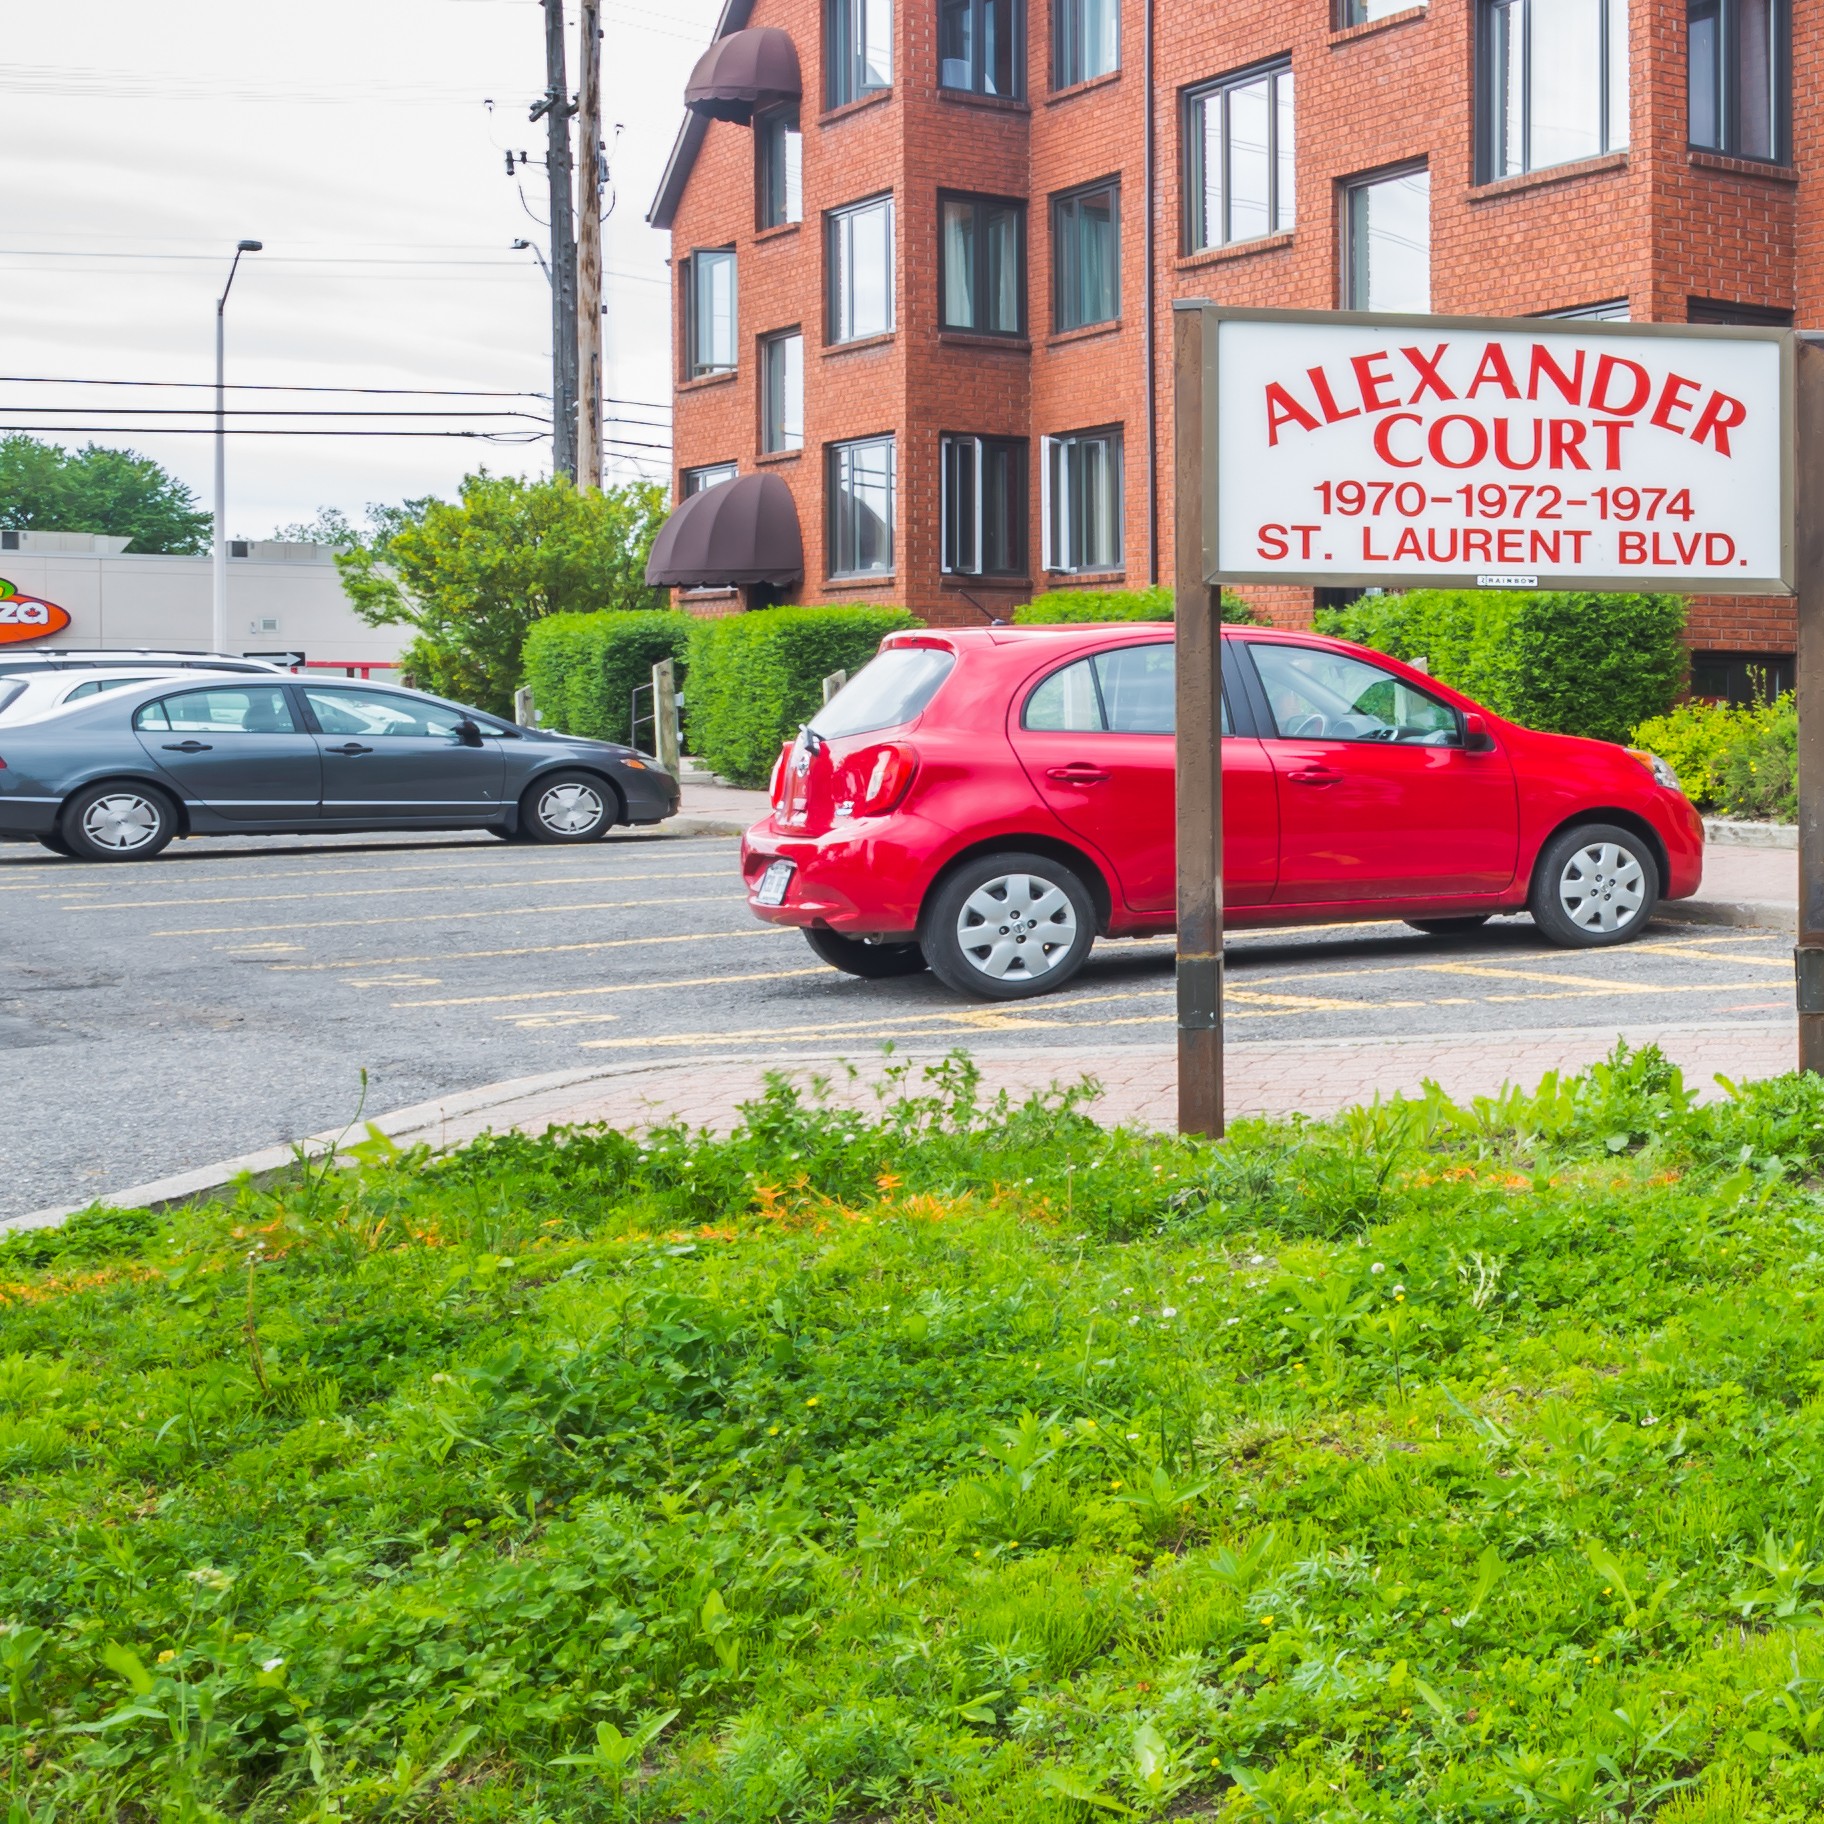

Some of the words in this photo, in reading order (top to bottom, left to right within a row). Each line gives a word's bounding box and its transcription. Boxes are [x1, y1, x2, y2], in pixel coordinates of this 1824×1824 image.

[1265, 342, 1747, 458] ALEXANDER
[1372, 412, 1635, 471] COURT
[1313, 480, 1695, 523] 1970-1972-1974
[1257, 523, 1333, 561] ST.
[1362, 526, 1592, 564] LAURENT
[1618, 530, 1747, 567] BLVD.
